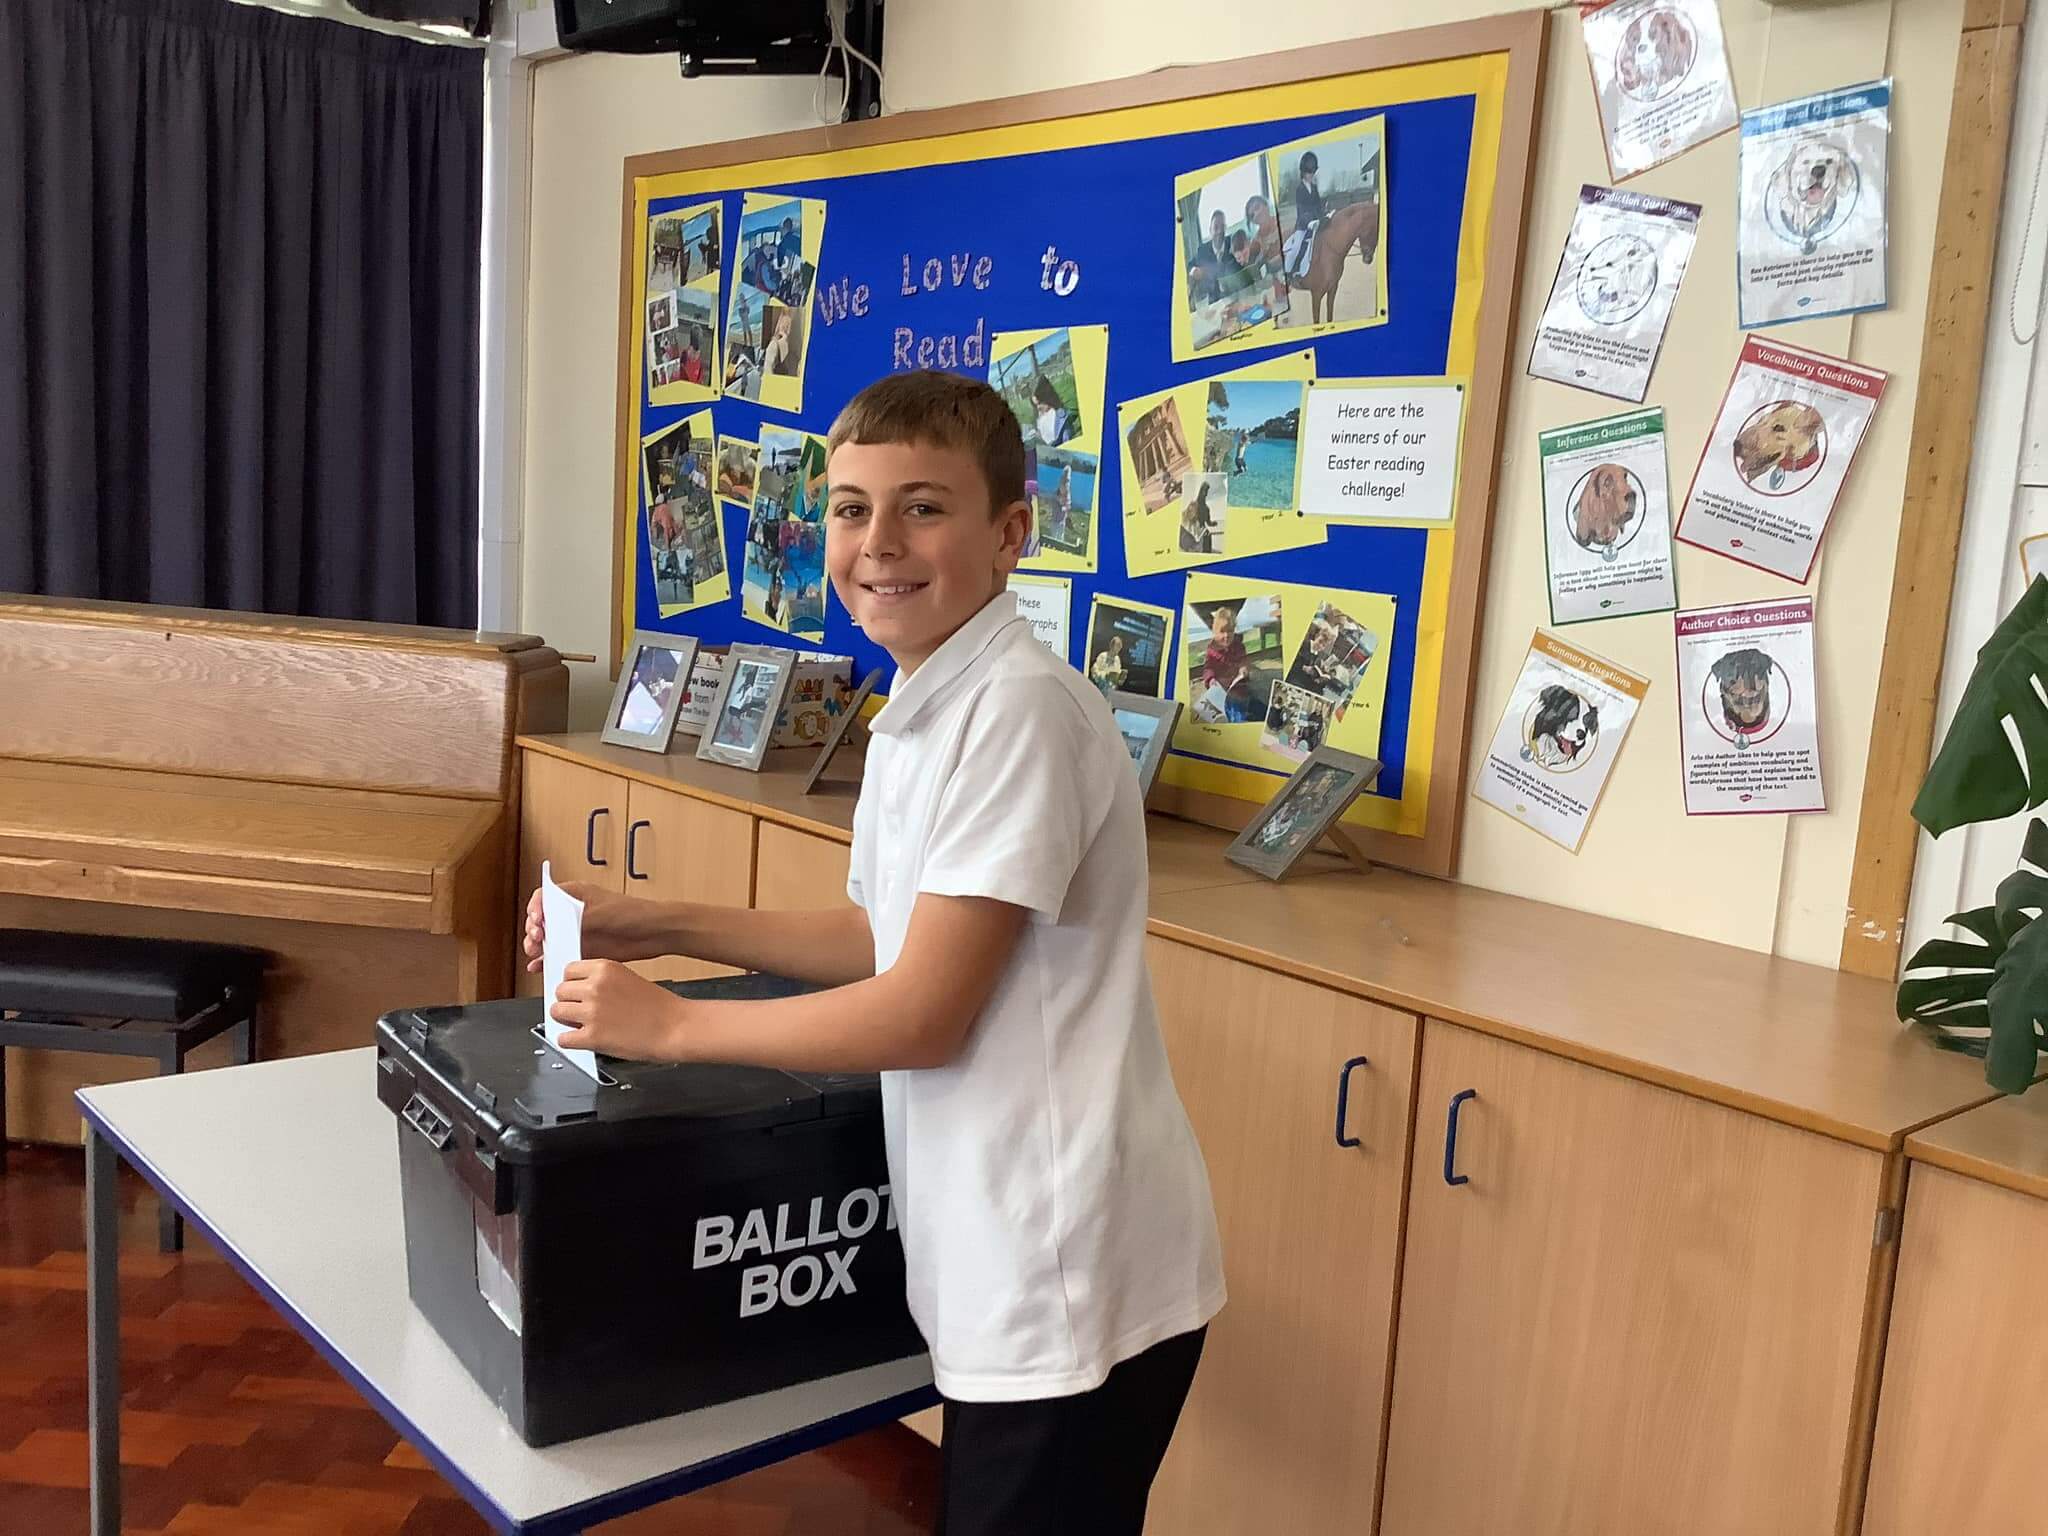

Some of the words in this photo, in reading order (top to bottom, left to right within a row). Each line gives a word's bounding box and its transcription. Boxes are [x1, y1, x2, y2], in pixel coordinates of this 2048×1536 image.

[1760, 105, 1808, 127] Retrieval
[1811, 96, 1867, 115] Questions
[1595, 189, 1639, 205] Prediction
[1642, 198, 1688, 215] Questions
[816, 276, 870, 326] We
[901, 252, 993, 296] Love
[1040, 246, 1080, 297] to
[893, 318, 985, 369] Read
[1757, 349, 1814, 375] Vocabulary
[1817, 367, 1869, 389] Questions
[1338, 404, 1369, 418] Here
[1373, 406, 1395, 418] are
[1401, 403, 1424, 418] the
[1331, 430, 1380, 444] winners
[1384, 429, 1399, 445] of
[1403, 433, 1426, 444] our
[1557, 432, 1599, 448] Inference
[1601, 422, 1647, 438] Questions
[1328, 455, 1370, 470] Easter
[1374, 456, 1425, 475] reading
[1342, 481, 1405, 501] challenge!
[1019, 597, 1041, 608] these
[1681, 619, 1715, 631] Author
[1718, 614, 1751, 626] Choice
[1753, 609, 1807, 623] Questions
[1547, 641, 1587, 667] Summary
[1589, 661, 1632, 688] Questions
[1693, 762, 1720, 770] examples
[693, 1184, 898, 1269] BALLOT
[740, 1245, 860, 1318] BOX
